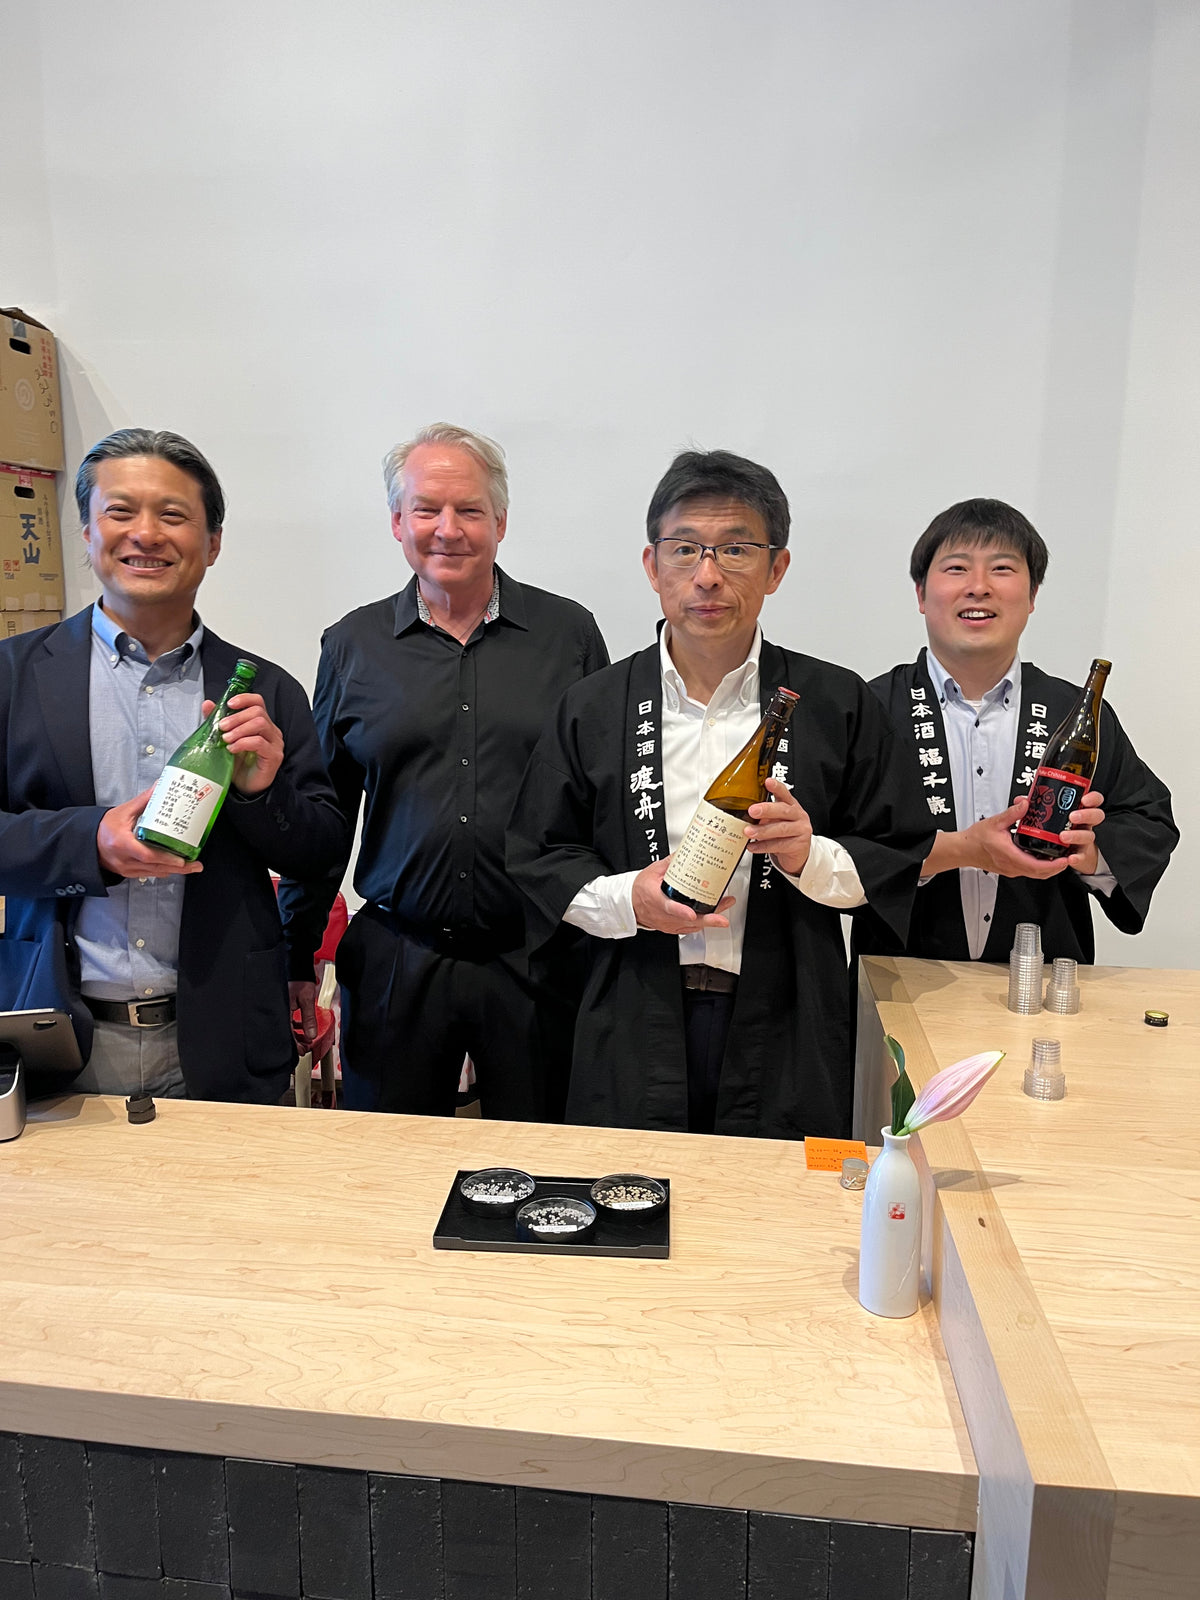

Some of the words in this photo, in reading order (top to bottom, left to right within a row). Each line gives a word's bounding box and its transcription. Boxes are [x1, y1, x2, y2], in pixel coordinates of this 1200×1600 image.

[19, 513, 41, 565] 天山
[1024, 703, 1049, 759] 日本酒
